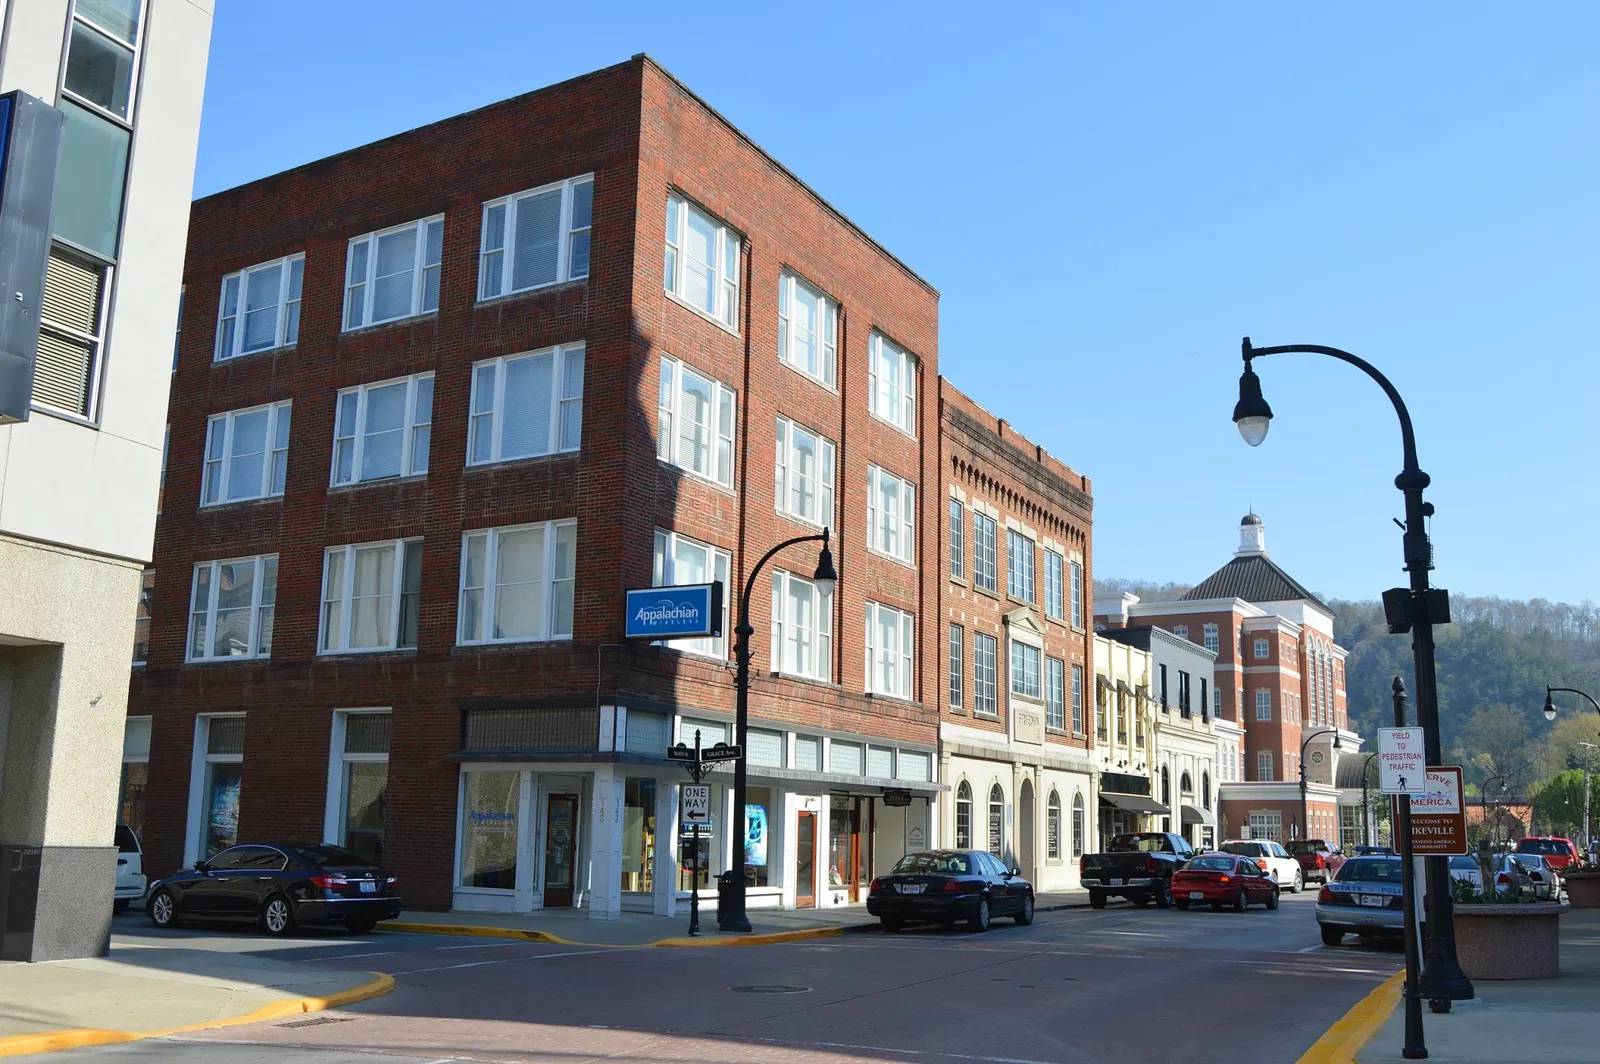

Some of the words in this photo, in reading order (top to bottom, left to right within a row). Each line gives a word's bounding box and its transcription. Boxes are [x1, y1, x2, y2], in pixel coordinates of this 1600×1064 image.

[635, 605, 699, 625] Appalachian
[1391, 732, 1410, 740] YIELD
[1397, 742, 1406, 750] TO
[1389, 763, 1416, 771] TRAFFIC
[1426, 774, 1452, 787] ERVE
[685, 788, 706, 798] ONE
[685, 798, 707, 808] WAY
[1411, 827, 1456, 835] IKEVILLE
